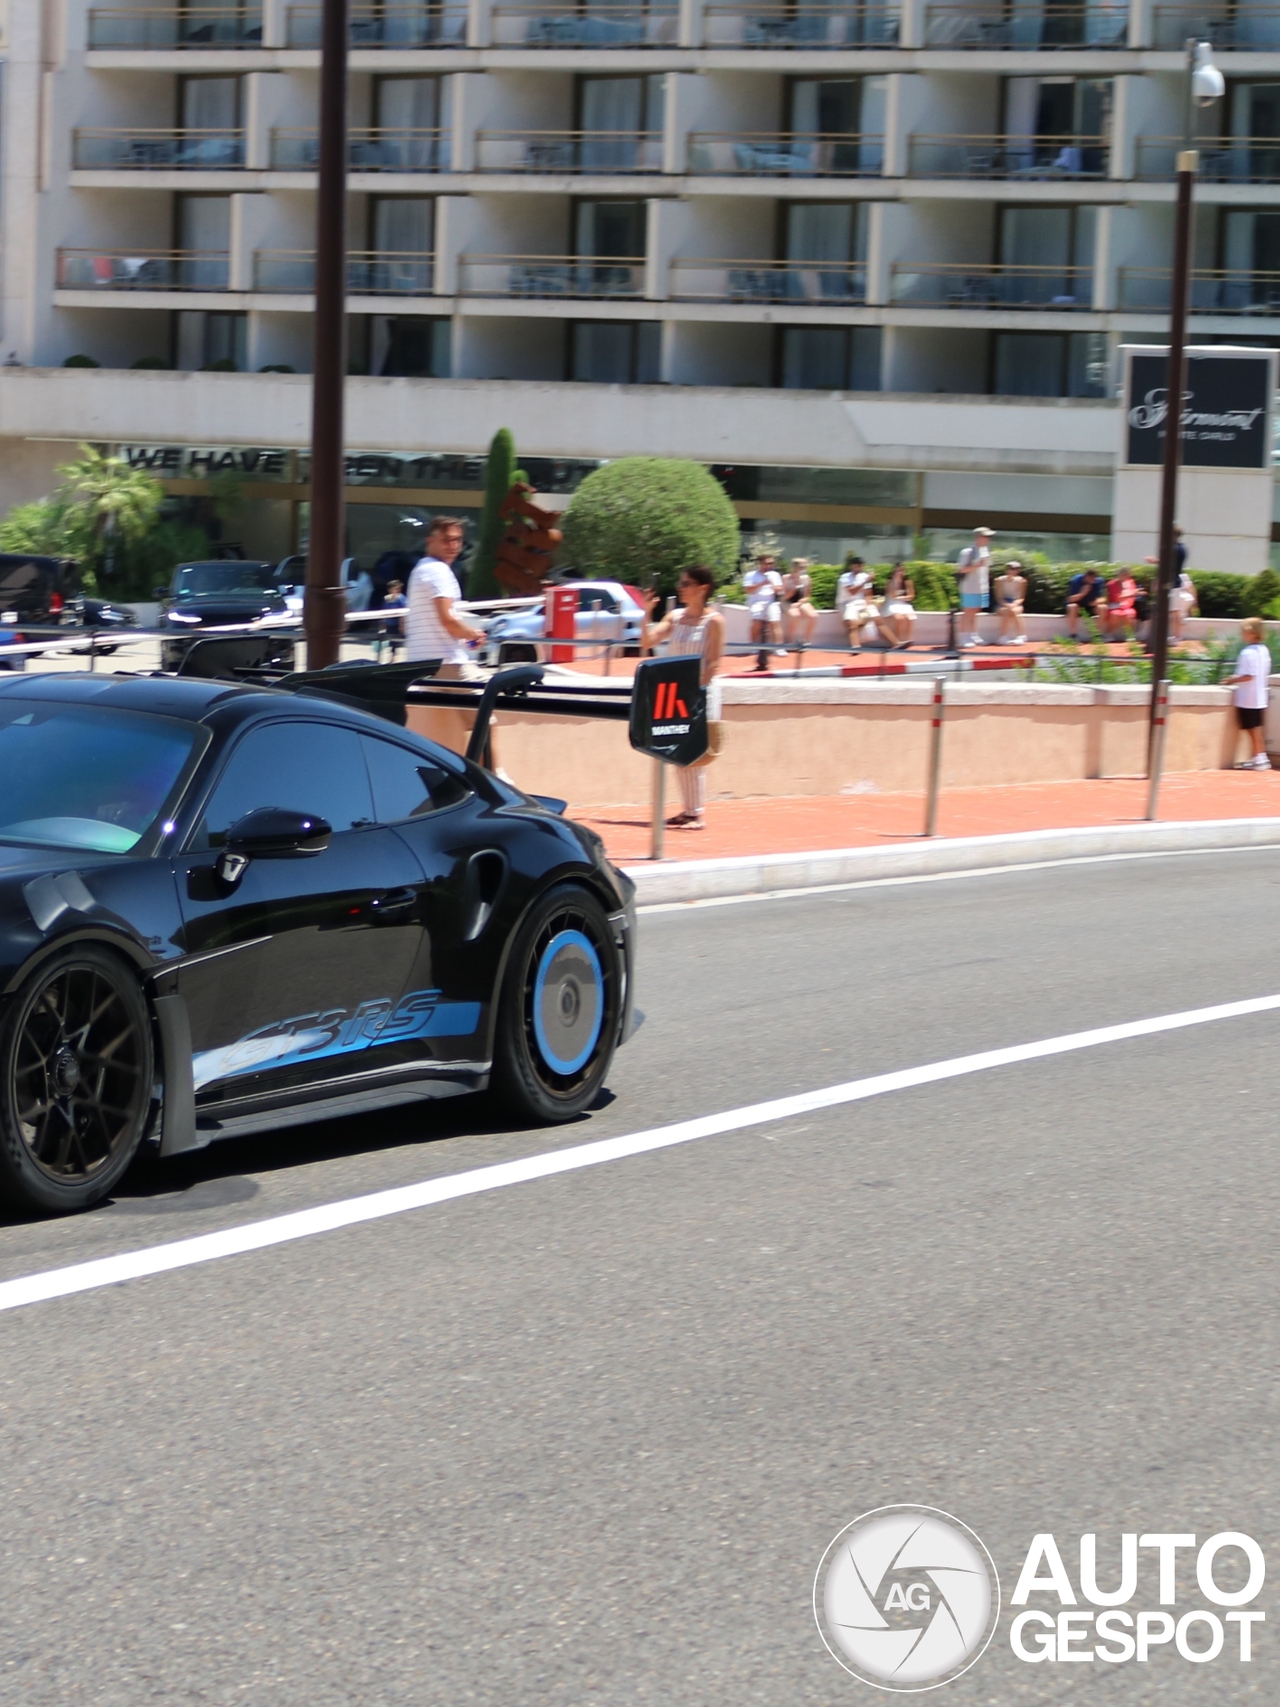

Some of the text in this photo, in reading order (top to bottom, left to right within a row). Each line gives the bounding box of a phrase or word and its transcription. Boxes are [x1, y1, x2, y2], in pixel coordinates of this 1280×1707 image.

[1128, 388, 1265, 430] Firmont
[127, 447, 183, 469] WE
[189, 449, 284, 473] HAVE
